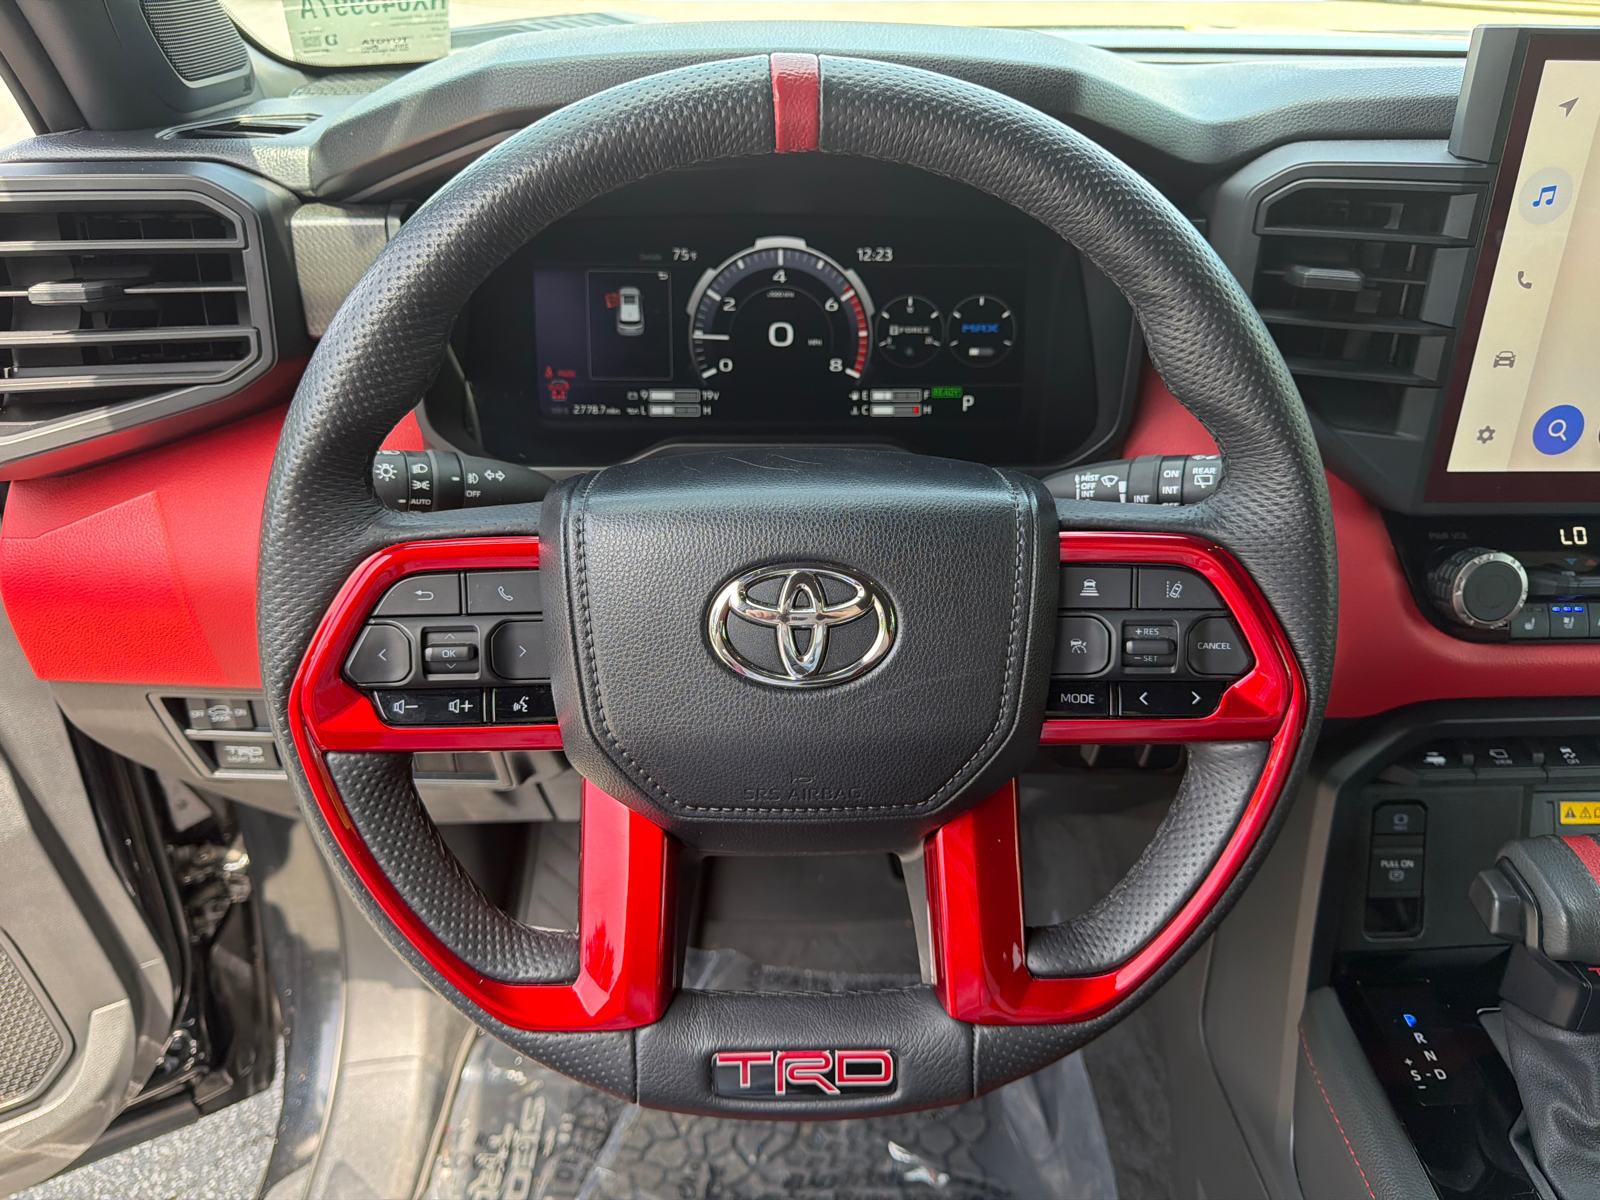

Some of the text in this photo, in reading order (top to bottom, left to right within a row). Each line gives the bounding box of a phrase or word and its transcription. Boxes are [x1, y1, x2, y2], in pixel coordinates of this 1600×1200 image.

[856, 247, 894, 262] 12:23
[772, 269, 787, 284] 4
[722, 297, 737, 312] 2
[824, 297, 839, 312] 6
[768, 321, 795, 347] 0
[718, 358, 734, 373] 0
[829, 358, 844, 373] 8
[861, 389, 870, 401] E
[932, 387, 962, 397] READY
[962, 394, 975, 412] P
[702, 405, 712, 416] H
[861, 404, 869, 416] C
[923, 404, 933, 415] H
[1163, 470, 1180, 478] ON
[1192, 467, 1216, 475] REAR
[1080, 474, 1100, 482] MIST
[1080, 482, 1096, 490] OFF
[1162, 485, 1179, 495] INT
[465, 490, 482, 498] OFF
[1080, 490, 1095, 498] INT
[1133, 495, 1150, 503] INT
[410, 498, 432, 506] AUTO
[1197, 642, 1232, 650] CANCEL
[441, 649, 456, 658] OK
[1060, 693, 1095, 704] MODE
[223, 746, 264, 757] TRD
[743, 788, 864, 802] SRS AIRBAG
[1400, 859, 1415, 869] ON
[1413, 1032, 1428, 1044] R
[1423, 1050, 1438, 1061] N
[716, 1049, 894, 1096] TRD
[1410, 1068, 1447, 1081] S D
